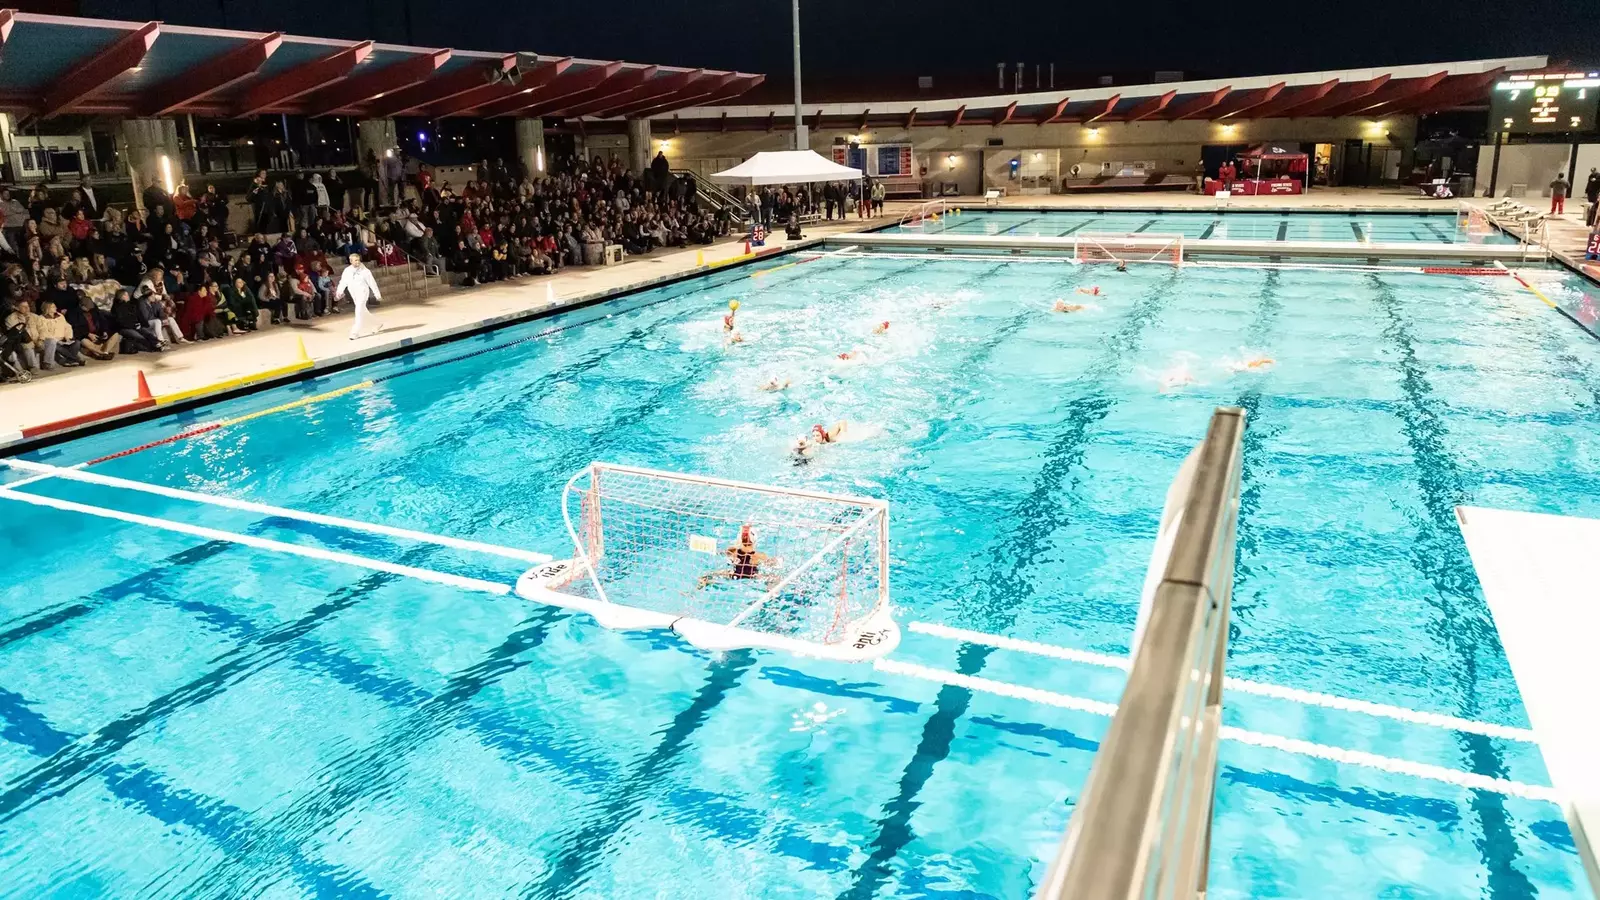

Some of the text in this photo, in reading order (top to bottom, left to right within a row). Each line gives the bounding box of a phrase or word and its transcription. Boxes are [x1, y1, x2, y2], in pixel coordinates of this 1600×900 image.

[1510, 89, 1521, 101] 7
[1577, 88, 1586, 100] 1
[753, 231, 764, 241] 28
[852, 631, 876, 649] anti
